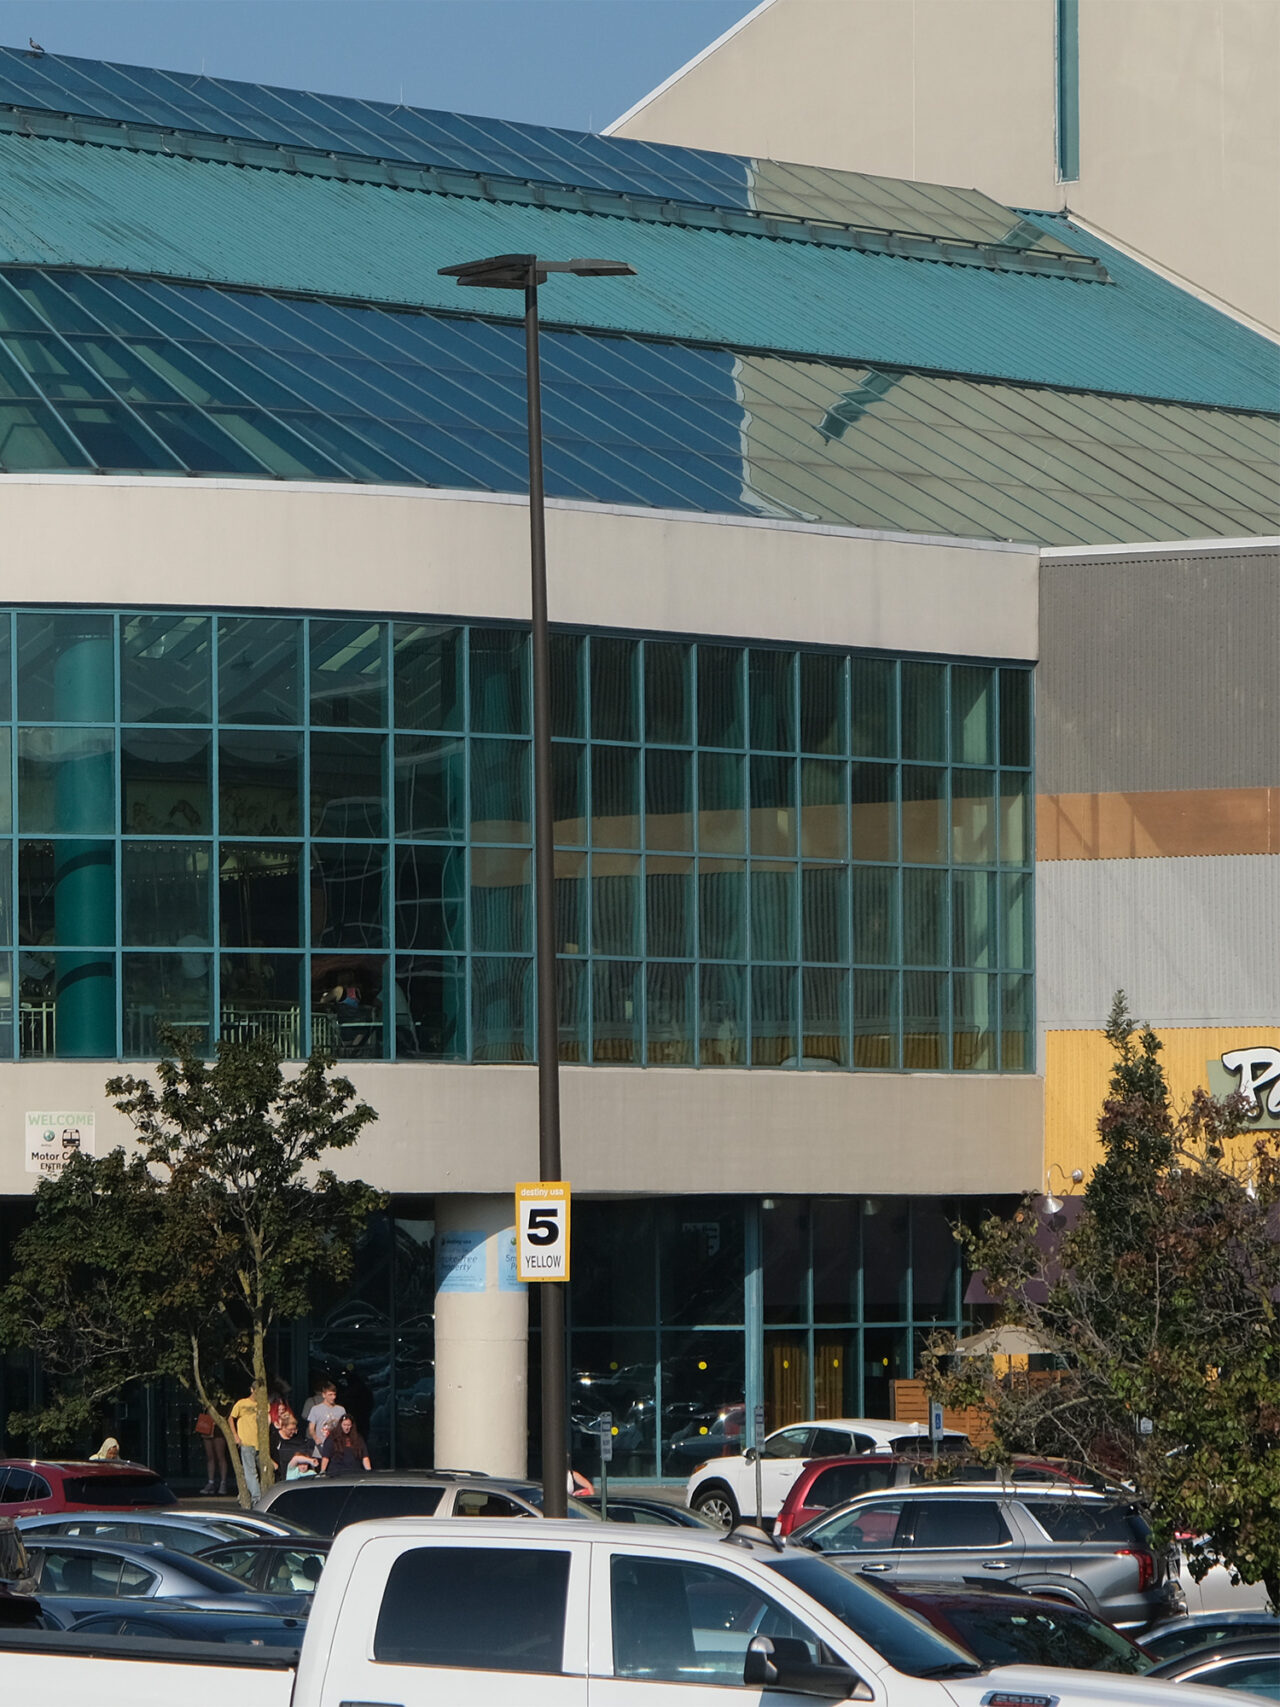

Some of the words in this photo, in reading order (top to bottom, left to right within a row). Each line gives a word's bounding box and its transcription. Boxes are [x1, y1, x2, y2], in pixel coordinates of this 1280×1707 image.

[28, 1114, 94, 1126] WELCOME
[31, 1152, 60, 1161] Motor
[521, 1188, 548, 1197] destiny
[527, 1208, 559, 1246] 5
[525, 1255, 561, 1268] YELLOW
[995, 1695, 1047, 1705] 2500
